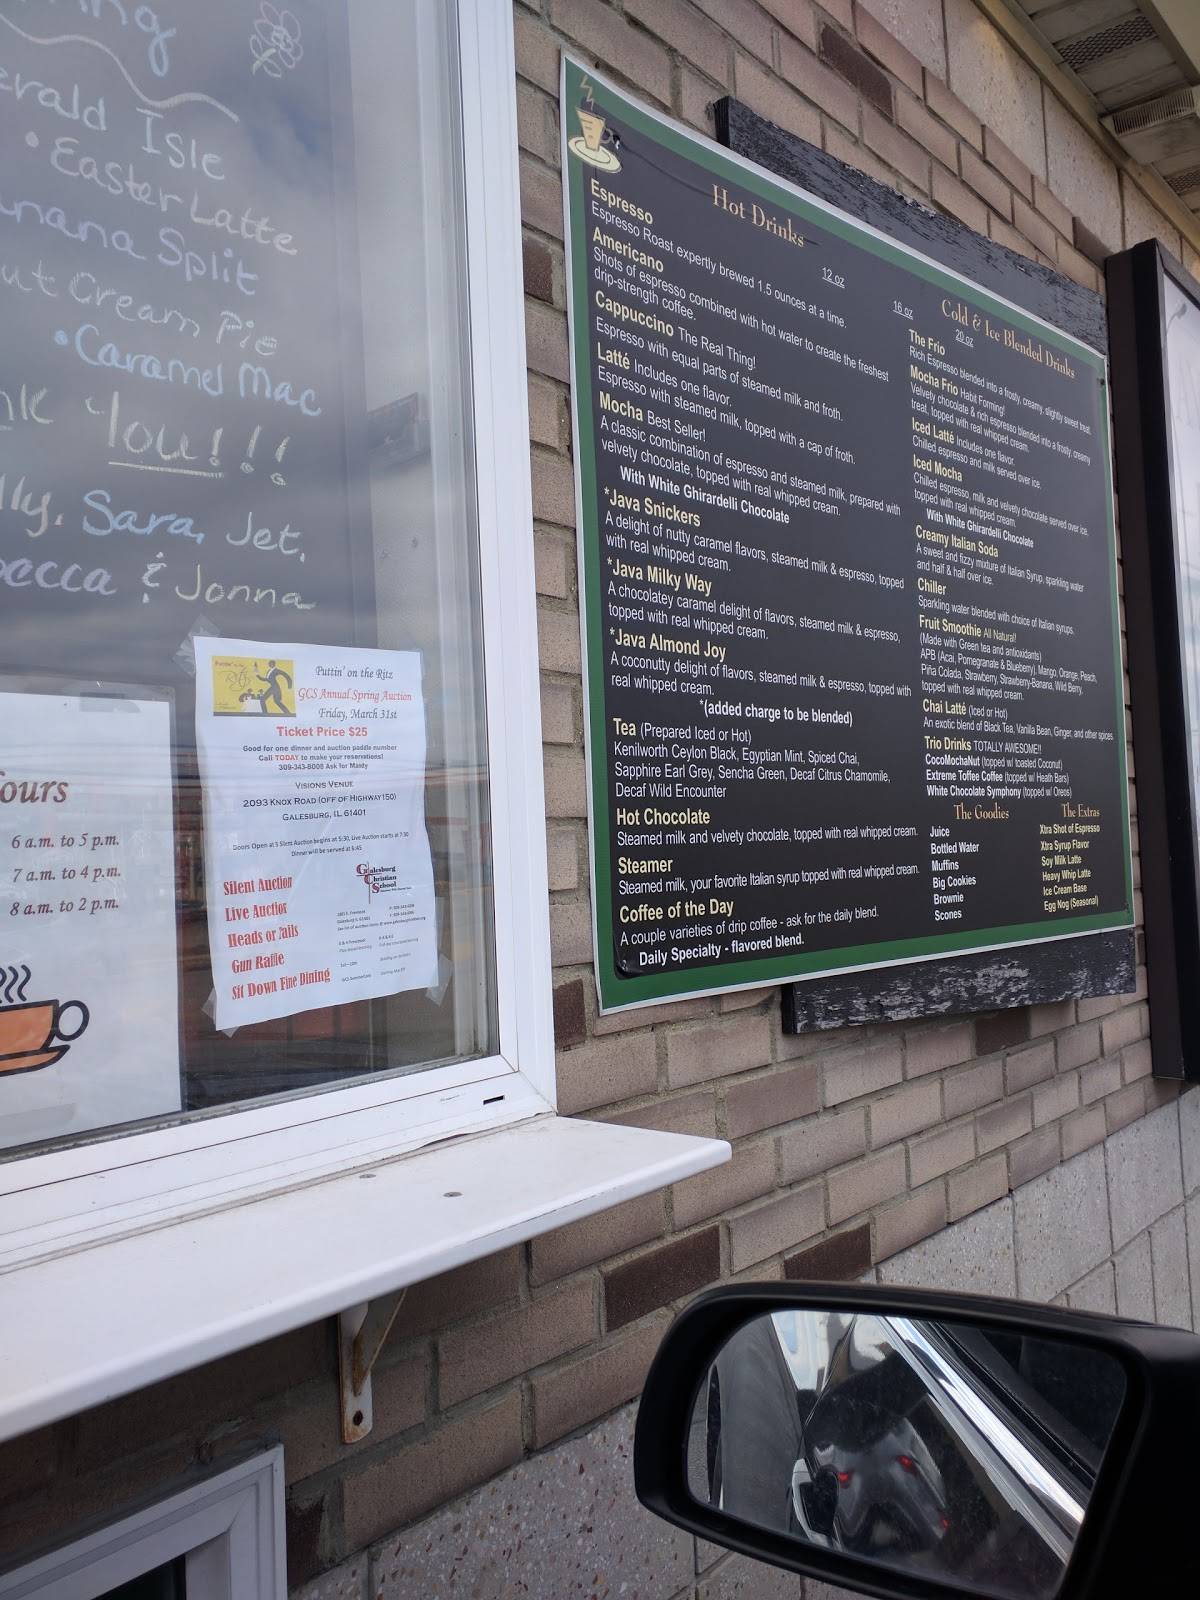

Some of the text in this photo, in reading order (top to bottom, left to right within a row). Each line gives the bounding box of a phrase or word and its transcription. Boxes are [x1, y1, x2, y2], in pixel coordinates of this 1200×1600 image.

[136, 107, 225, 180] Isle
[591, 178, 654, 224] Espresso
[711, 184, 805, 248] Hot Drinks
[592, 226, 664, 273] Americano
[158, 227, 259, 296] Split
[591, 200, 847, 329] Espresso Roast expertly brewed 1.5 ounces at a time.
[68, 271, 200, 337] Cream
[216, 310, 279, 356] Pie
[595, 290, 674, 337] Cappuccino
[908, 328, 946, 356] The Frio
[941, 298, 1076, 380] Cold & Ice Blended Drinks
[597, 342, 631, 370] Latté
[239, 362, 321, 417] Mac
[910, 364, 959, 396] Mocha Frio
[599, 391, 643, 422] Mocha
[912, 417, 955, 445] Iced Latté
[913, 454, 963, 482] Iced Mocha
[620, 465, 790, 524] With White Ghirardelli Chocolate
[644, 497, 701, 527] Snickers
[915, 524, 999, 558] Creamy Italian Soda
[175, 563, 316, 610] Jonna
[647, 564, 681, 592] Milky
[685, 572, 712, 597] Way
[917, 577, 947, 596] Chiller
[919, 614, 982, 638] Fruit Smoothie
[649, 633, 700, 657] Almond
[703, 641, 726, 663] Joy
[347, 669, 358, 678] on
[360, 668, 373, 678] the
[376, 668, 394, 680] Ritz
[298, 688, 412, 704] GCS Annual Spring Auction
[318, 707, 397, 721] Friday, March 31st
[922, 698, 966, 716] Chai Latté
[276, 726, 368, 737] Ticket Price $25
[612, 717, 637, 736] Tea
[924, 735, 972, 751] Trio Drinks
[0, 771, 69, 803] ours
[243, 799, 269, 808] 2093
[294, 797, 317, 805] ROAD
[953, 802, 1010, 821] The Goodies
[1061, 802, 1100, 819] The Extras
[343, 808, 366, 817] 61401
[616, 807, 710, 826] Hot Chocolate
[929, 825, 950, 838] Juice
[1053, 823, 1067, 834] Shot
[1068, 823, 1074, 833] of
[1074, 823, 1101, 835] Espresso
[11, 833, 120, 850] 6 a.m. to 5 p.m.
[930, 841, 980, 855] Bottled Water
[13, 865, 121, 883] 7 a.m. to 4 p.m.
[618, 856, 673, 875] Steamer
[931, 860, 960, 872] Muffins
[223, 876, 293, 896] Silent Auction
[364, 873, 397, 885] Christian
[372, 881, 397, 894] School
[932, 874, 977, 891] Big Cookies
[9, 897, 119, 916] 8 a.m. to 2 p.m.
[933, 892, 964, 905] Brownie
[225, 902, 288, 922] Live Auction
[619, 898, 734, 924] Coffee of the Day
[934, 909, 962, 922] Scones
[227, 931, 264, 948] Heads
[266, 930, 277, 942] or
[231, 958, 252, 974] Gun
[232, 983, 244, 1000] Sit
[247, 980, 277, 997] Down
[280, 974, 298, 991] Fine
[300, 968, 331, 987] Dining
